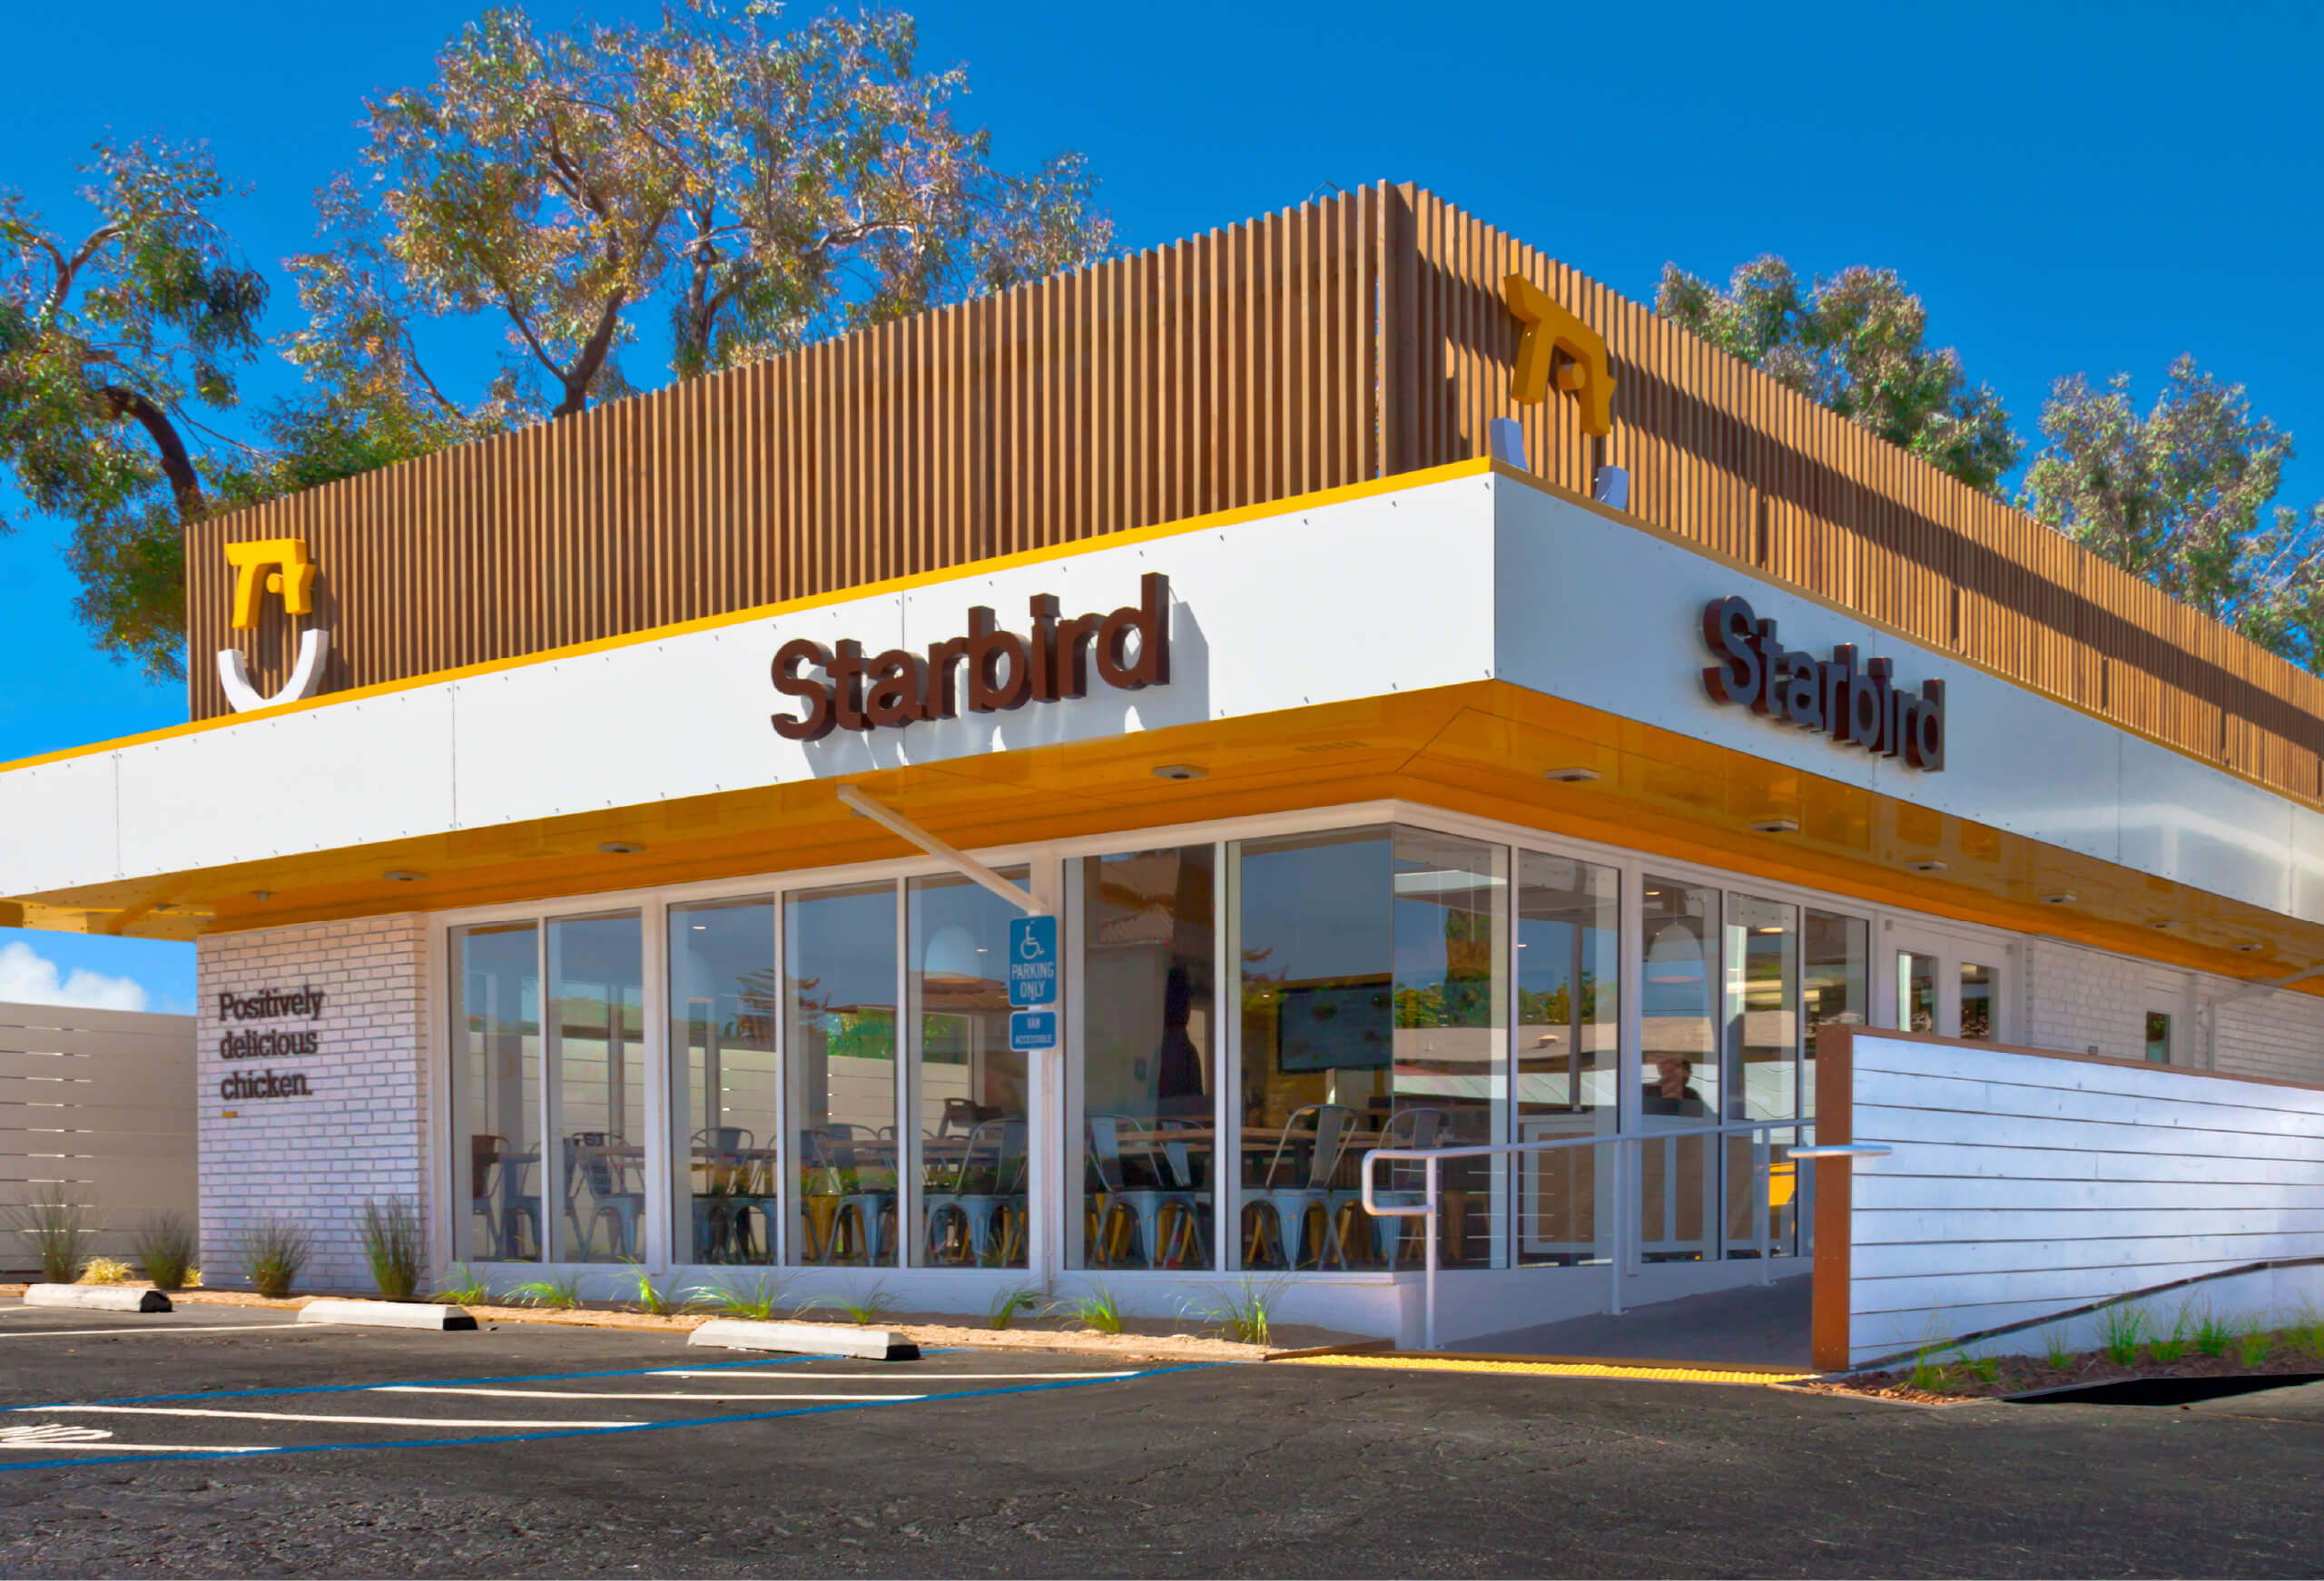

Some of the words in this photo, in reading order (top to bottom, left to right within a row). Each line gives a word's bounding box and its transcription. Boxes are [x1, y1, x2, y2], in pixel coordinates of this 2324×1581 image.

[771, 572, 1170, 741] Starbird
[1702, 595, 1945, 772] Starbird
[1012, 962, 1054, 980] PARKING
[219, 985, 324, 1021] Positively
[1019, 981, 1046, 997] ONLY
[220, 1028, 318, 1059] delicious
[221, 1068, 313, 1100] chicken.
